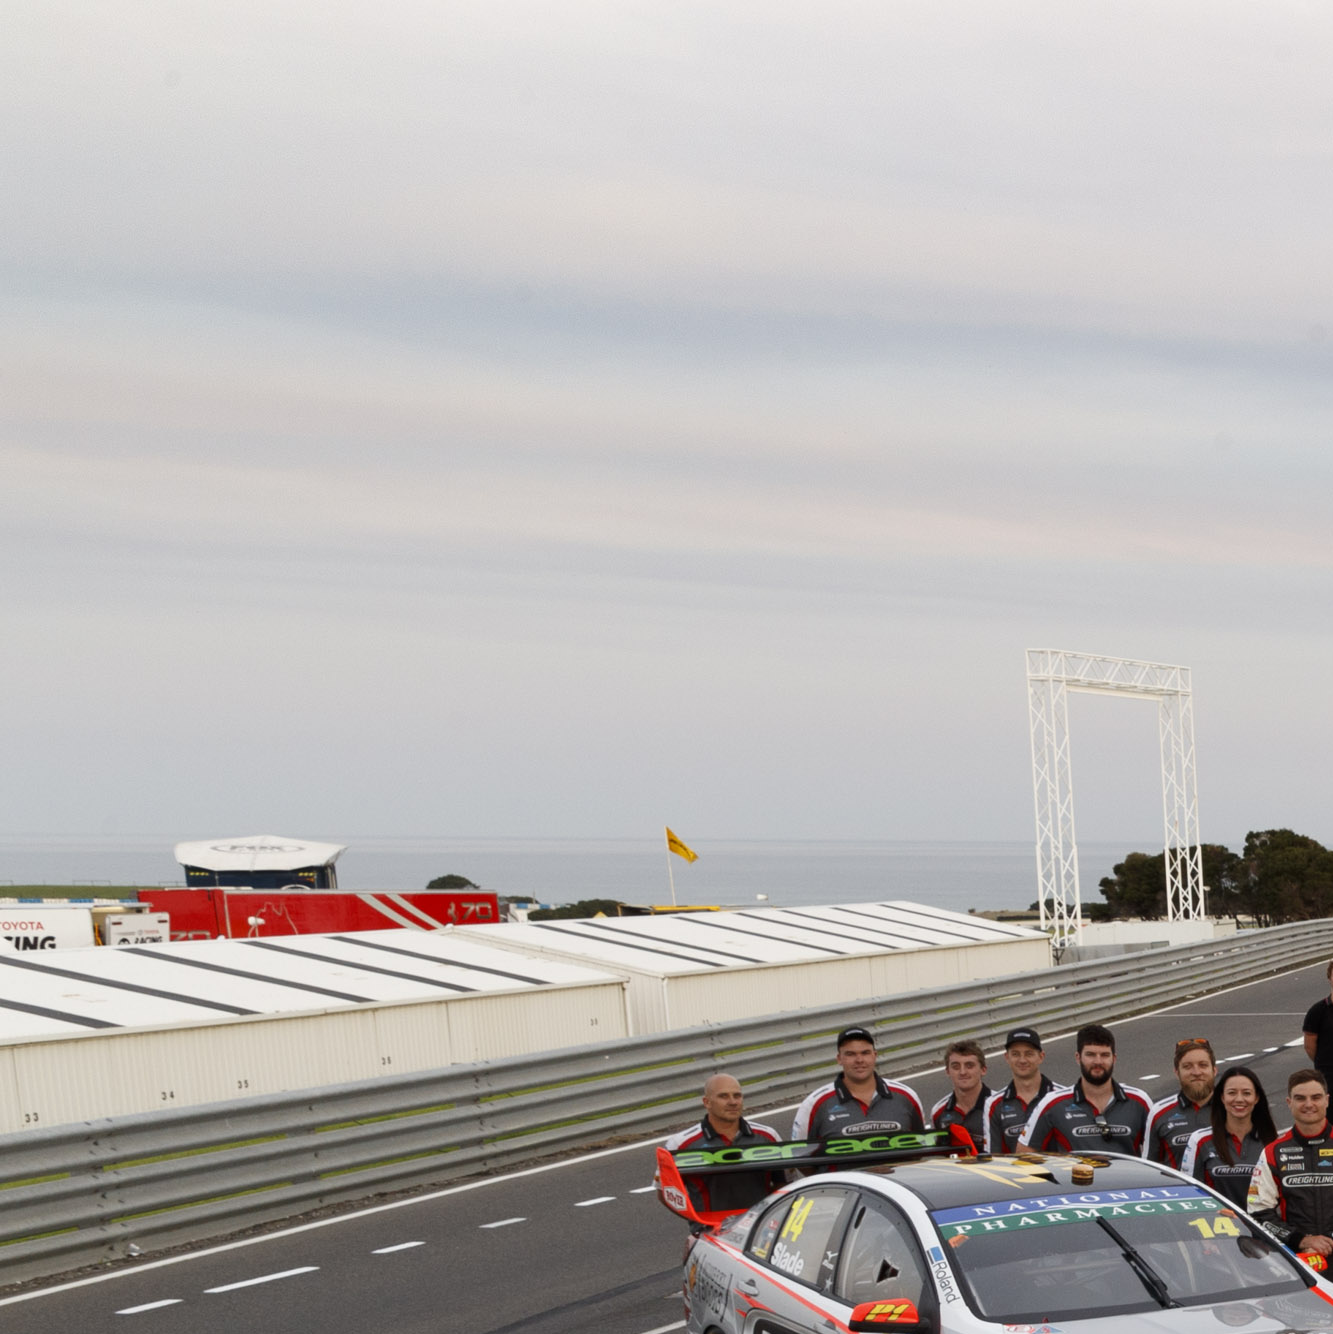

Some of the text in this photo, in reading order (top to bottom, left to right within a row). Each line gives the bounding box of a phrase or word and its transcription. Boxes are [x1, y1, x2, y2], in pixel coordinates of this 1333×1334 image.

[3, 935, 56, 950] ING
[845, 1121, 898, 1135] FREIGHTLINER
[1078, 1126, 1127, 1135] FREIGHINER
[675, 1142, 807, 1168] acer
[825, 1131, 949, 1155] acer
[976, 1189, 1179, 1217] NATIONAL
[781, 1196, 814, 1242] 14
[954, 1199, 1220, 1235] PHARMACIES
[1188, 1217, 1241, 1239] 14
[770, 1242, 805, 1277] Slade
[932, 1261, 960, 1304] Roland
